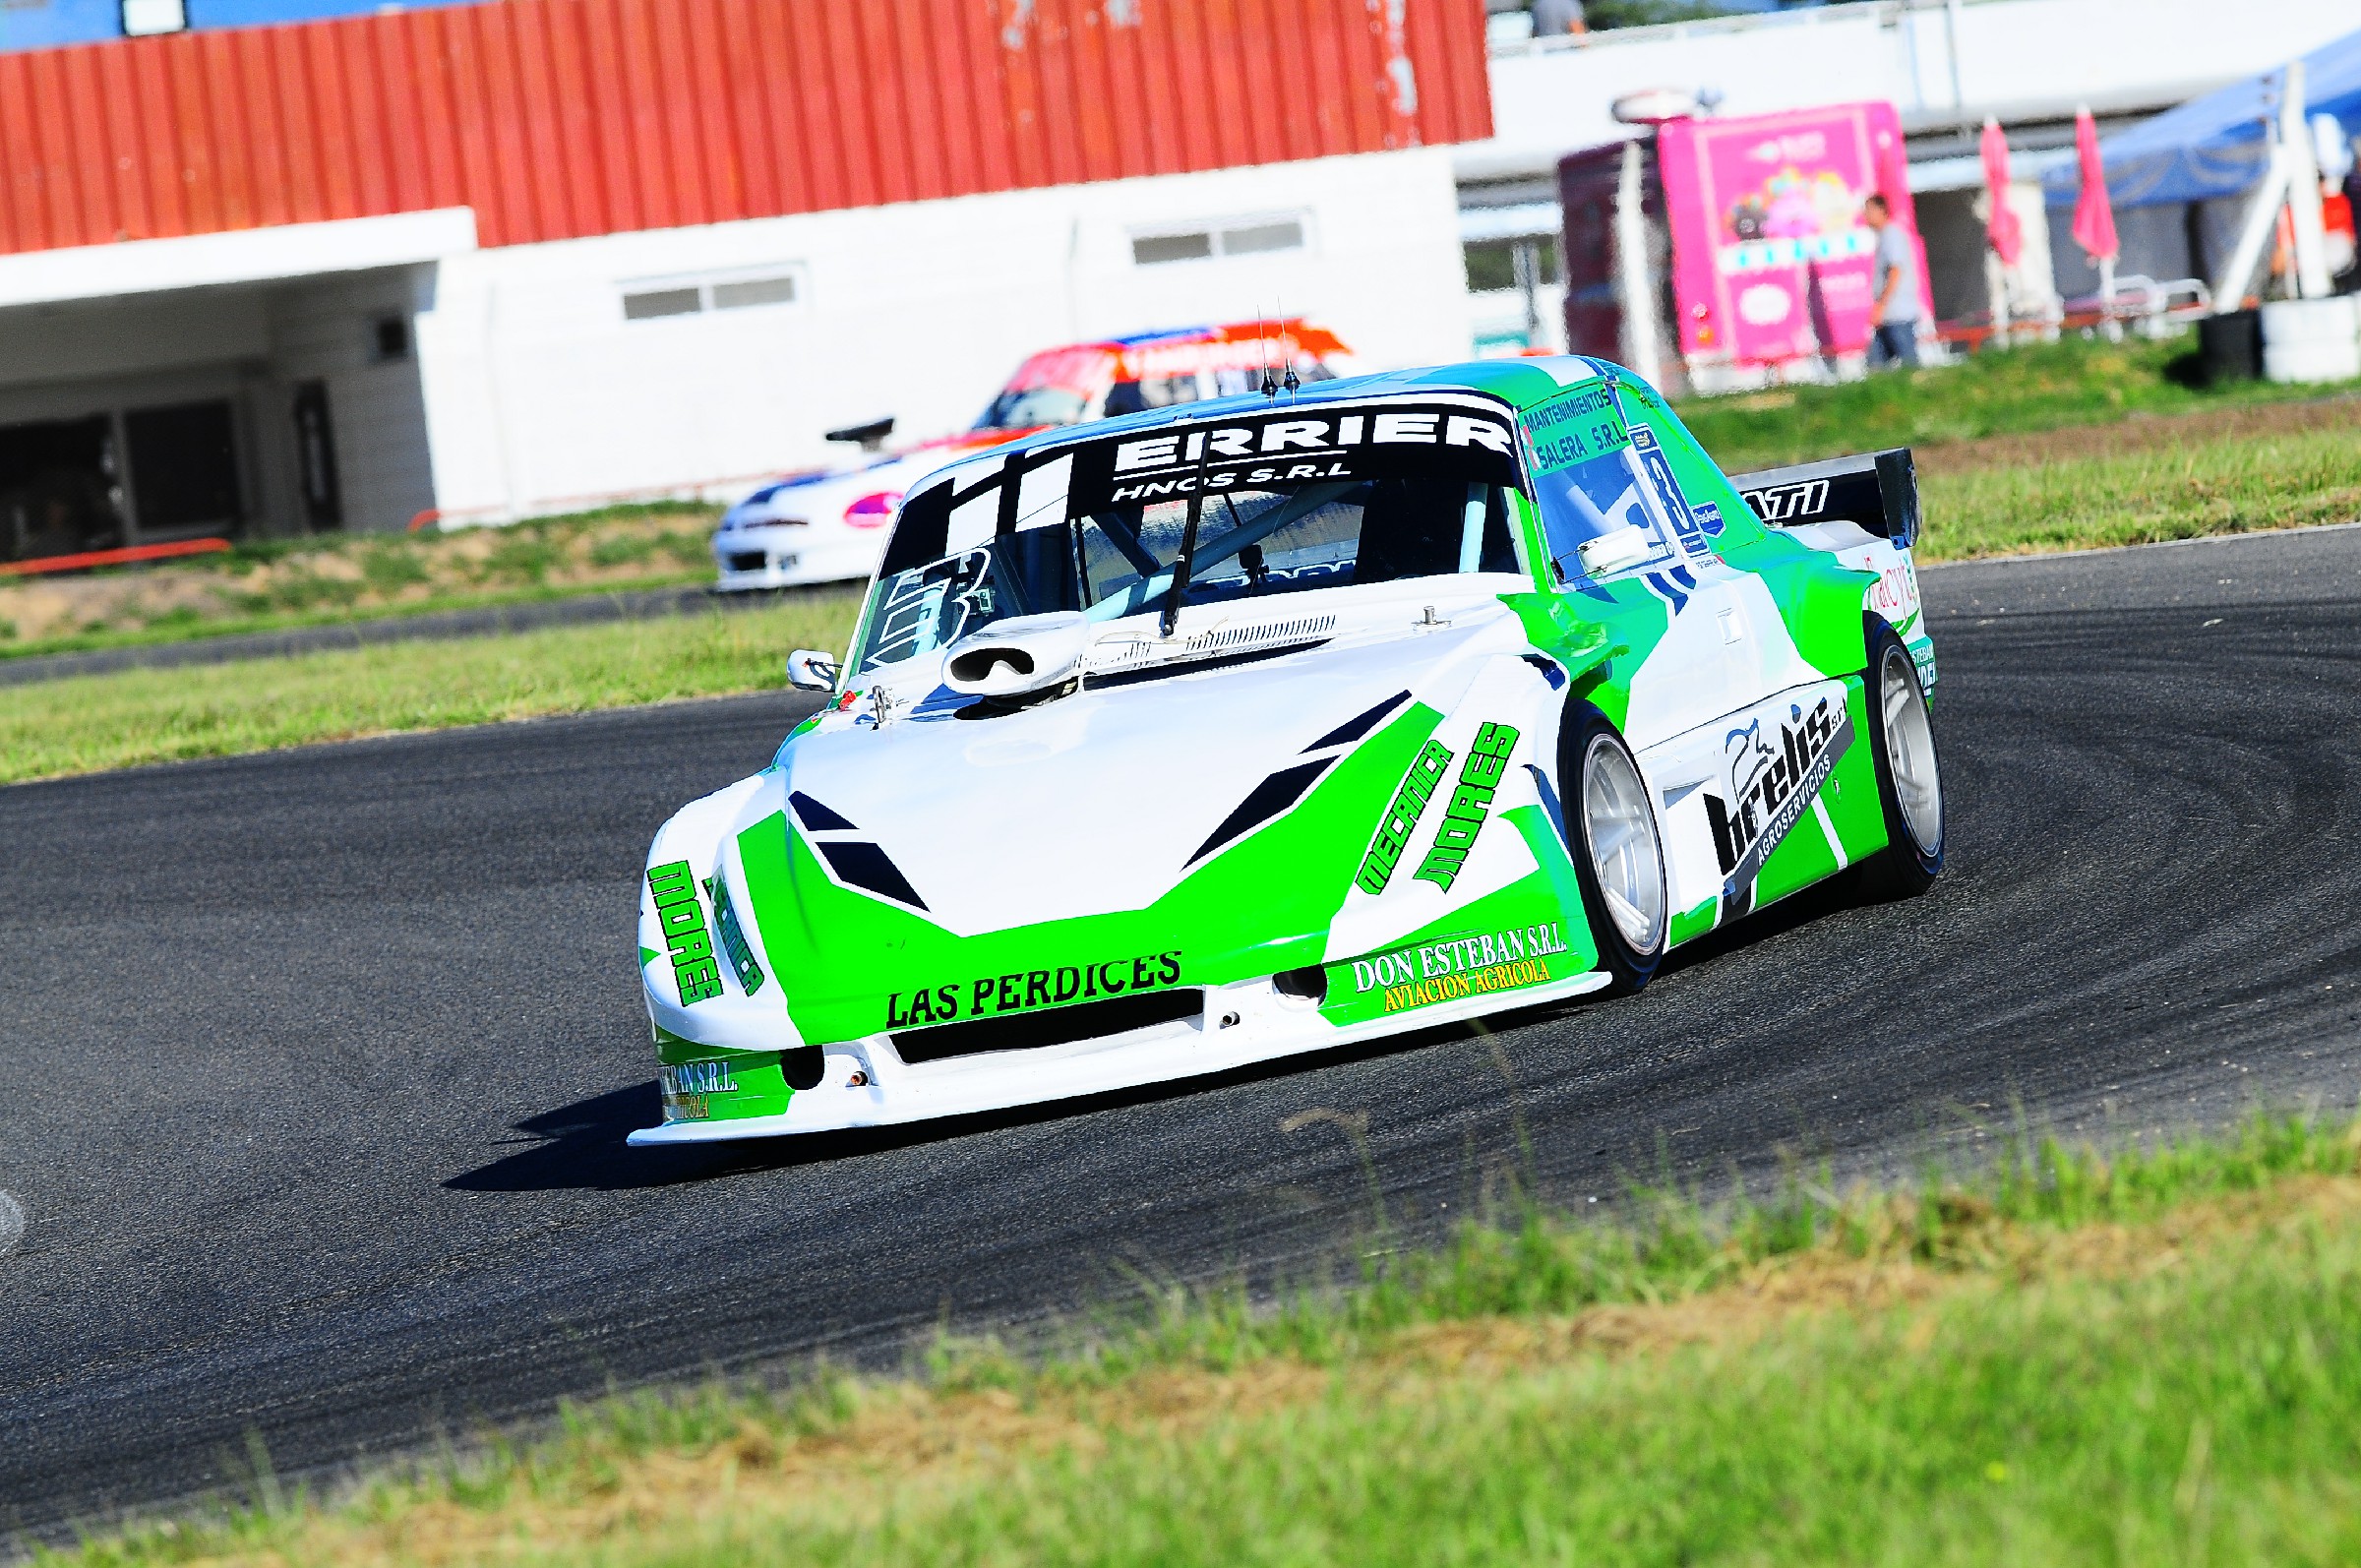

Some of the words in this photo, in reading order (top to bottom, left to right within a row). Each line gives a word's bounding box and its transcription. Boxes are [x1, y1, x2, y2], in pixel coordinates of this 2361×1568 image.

[1115, 413, 1514, 472] ERRIER
[1523, 389, 1612, 434] MANTENIMIENTOS
[1246, 462, 1352, 483] S.R.L
[1536, 433, 1589, 470] SALERA
[1355, 739, 1455, 896] MECANICA
[1413, 721, 1520, 895] MORES
[1756, 754, 1832, 868] AGROSERVICIOS
[646, 860, 724, 1007] MORES
[1351, 955, 1415, 994] DON
[1419, 929, 1525, 980] ESTEBAN
[1528, 922, 1567, 958] S.R.L.
[886, 982, 960, 1030] LAS
[970, 950, 1182, 1016] PERDICES
[1384, 976, 1472, 1013] AVIACION
[1475, 957, 1551, 995] AGRICOLA
